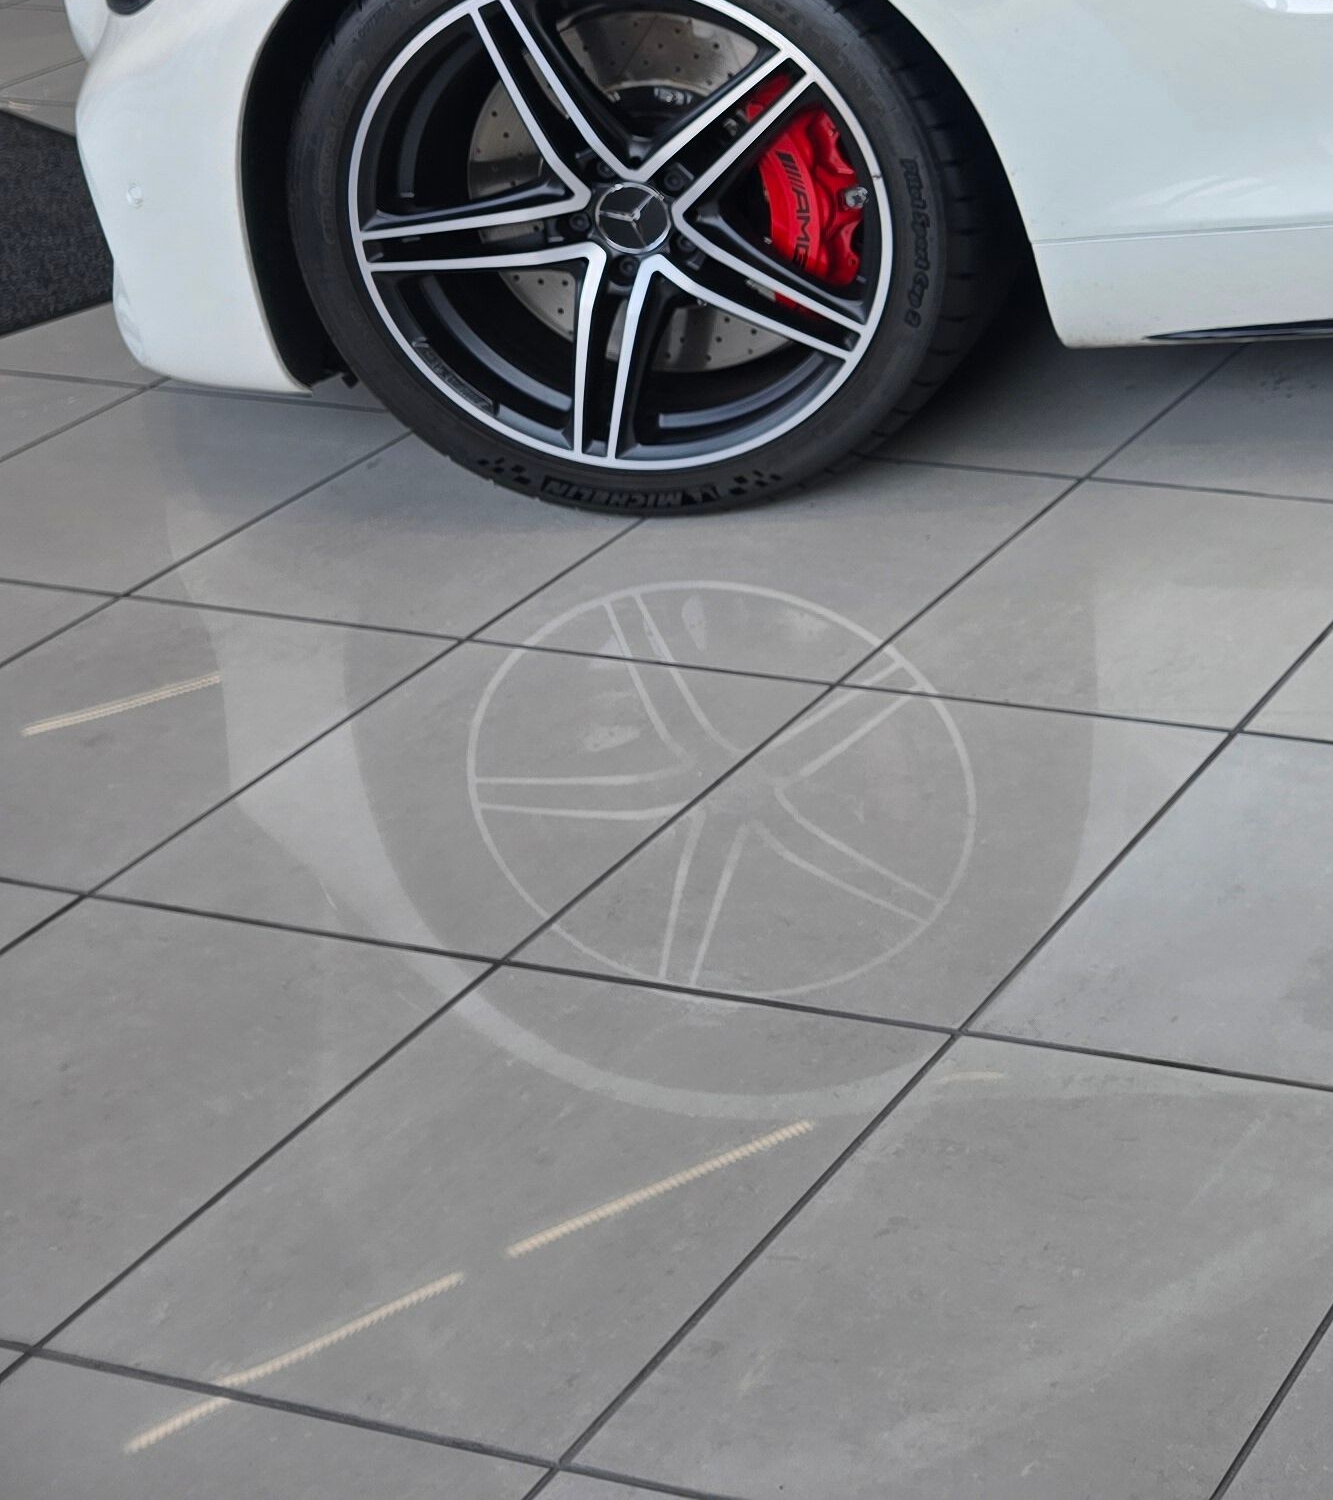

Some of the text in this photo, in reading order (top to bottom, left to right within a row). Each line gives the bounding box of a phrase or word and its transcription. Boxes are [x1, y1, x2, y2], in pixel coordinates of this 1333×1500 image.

[901, 158, 927, 210] Pilot
[911, 211, 931, 271] Sport
[908, 271, 930, 309] Cup
[544, 478, 683, 509] MICHELIN
